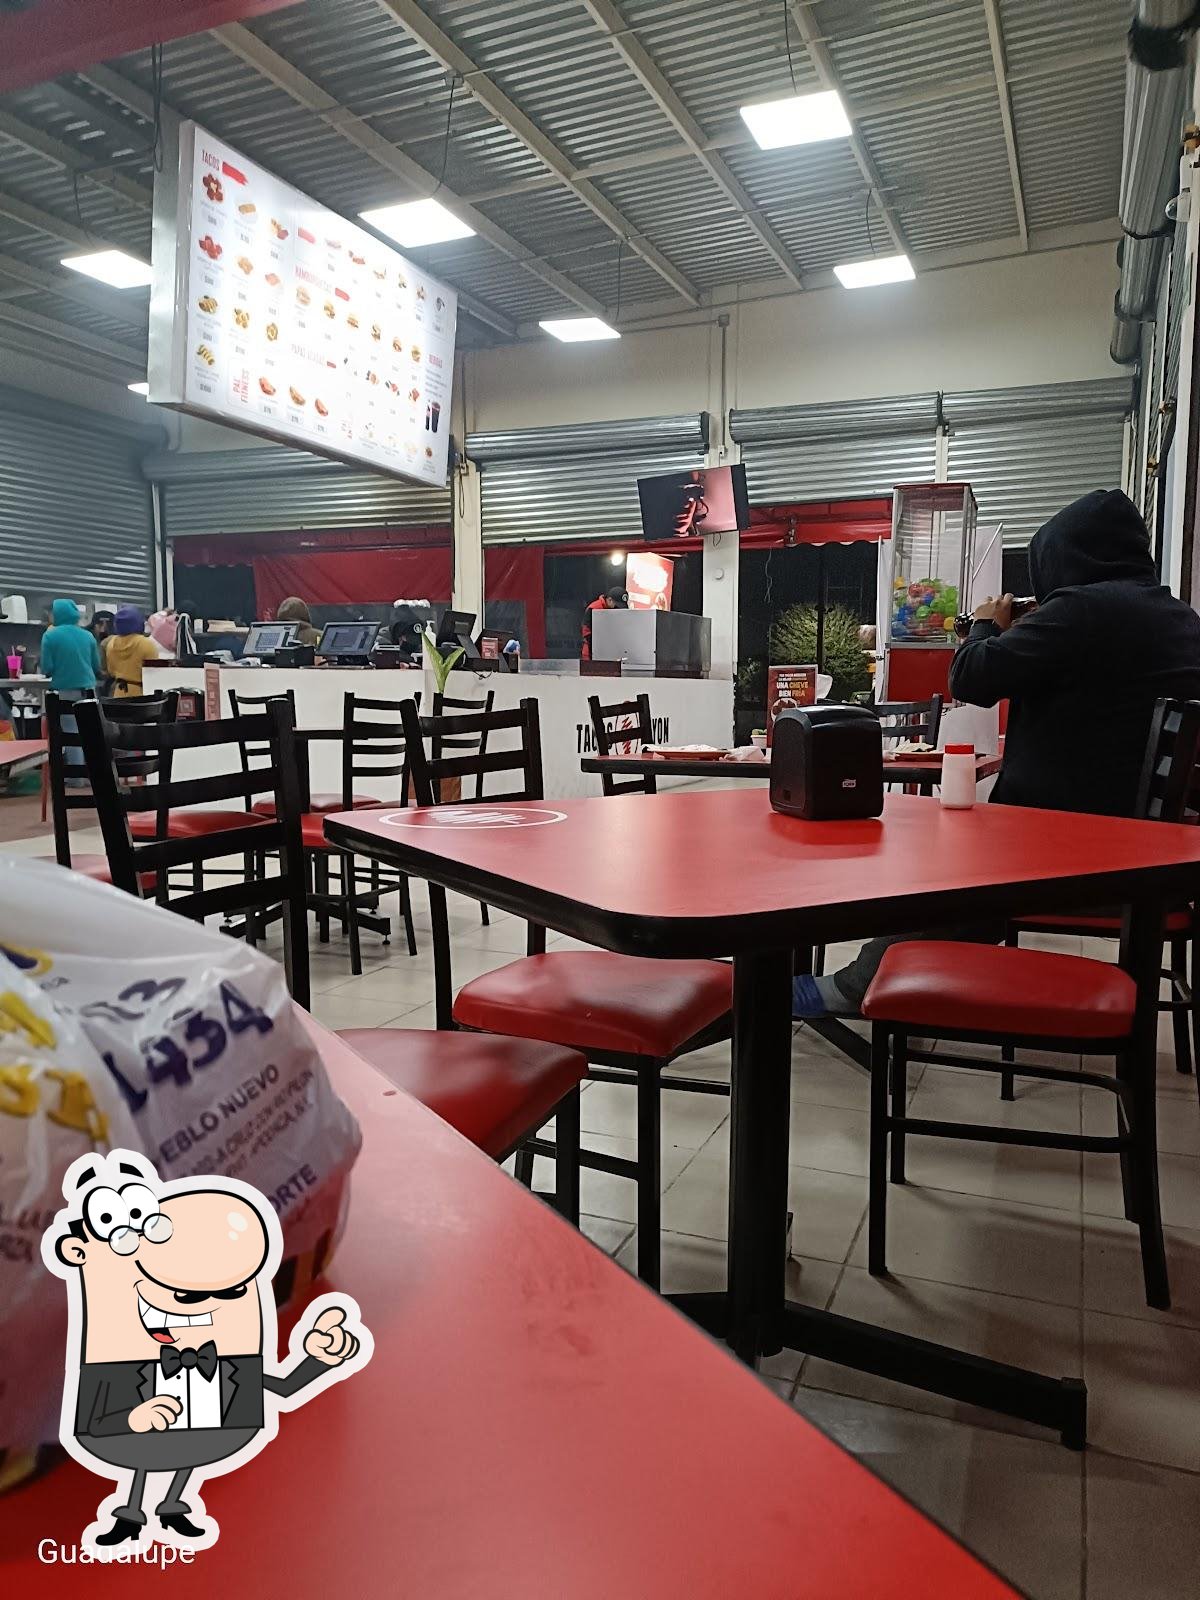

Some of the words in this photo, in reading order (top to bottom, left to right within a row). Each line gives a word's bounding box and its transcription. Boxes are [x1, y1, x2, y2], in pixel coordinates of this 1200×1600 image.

[202, 149, 220, 171] TACOS
[776, 681, 789, 689] UNA
[778, 689, 791, 697] BIEN
[576, 721, 613, 753] TACS
[218, 1063, 280, 1119] NUEVO
